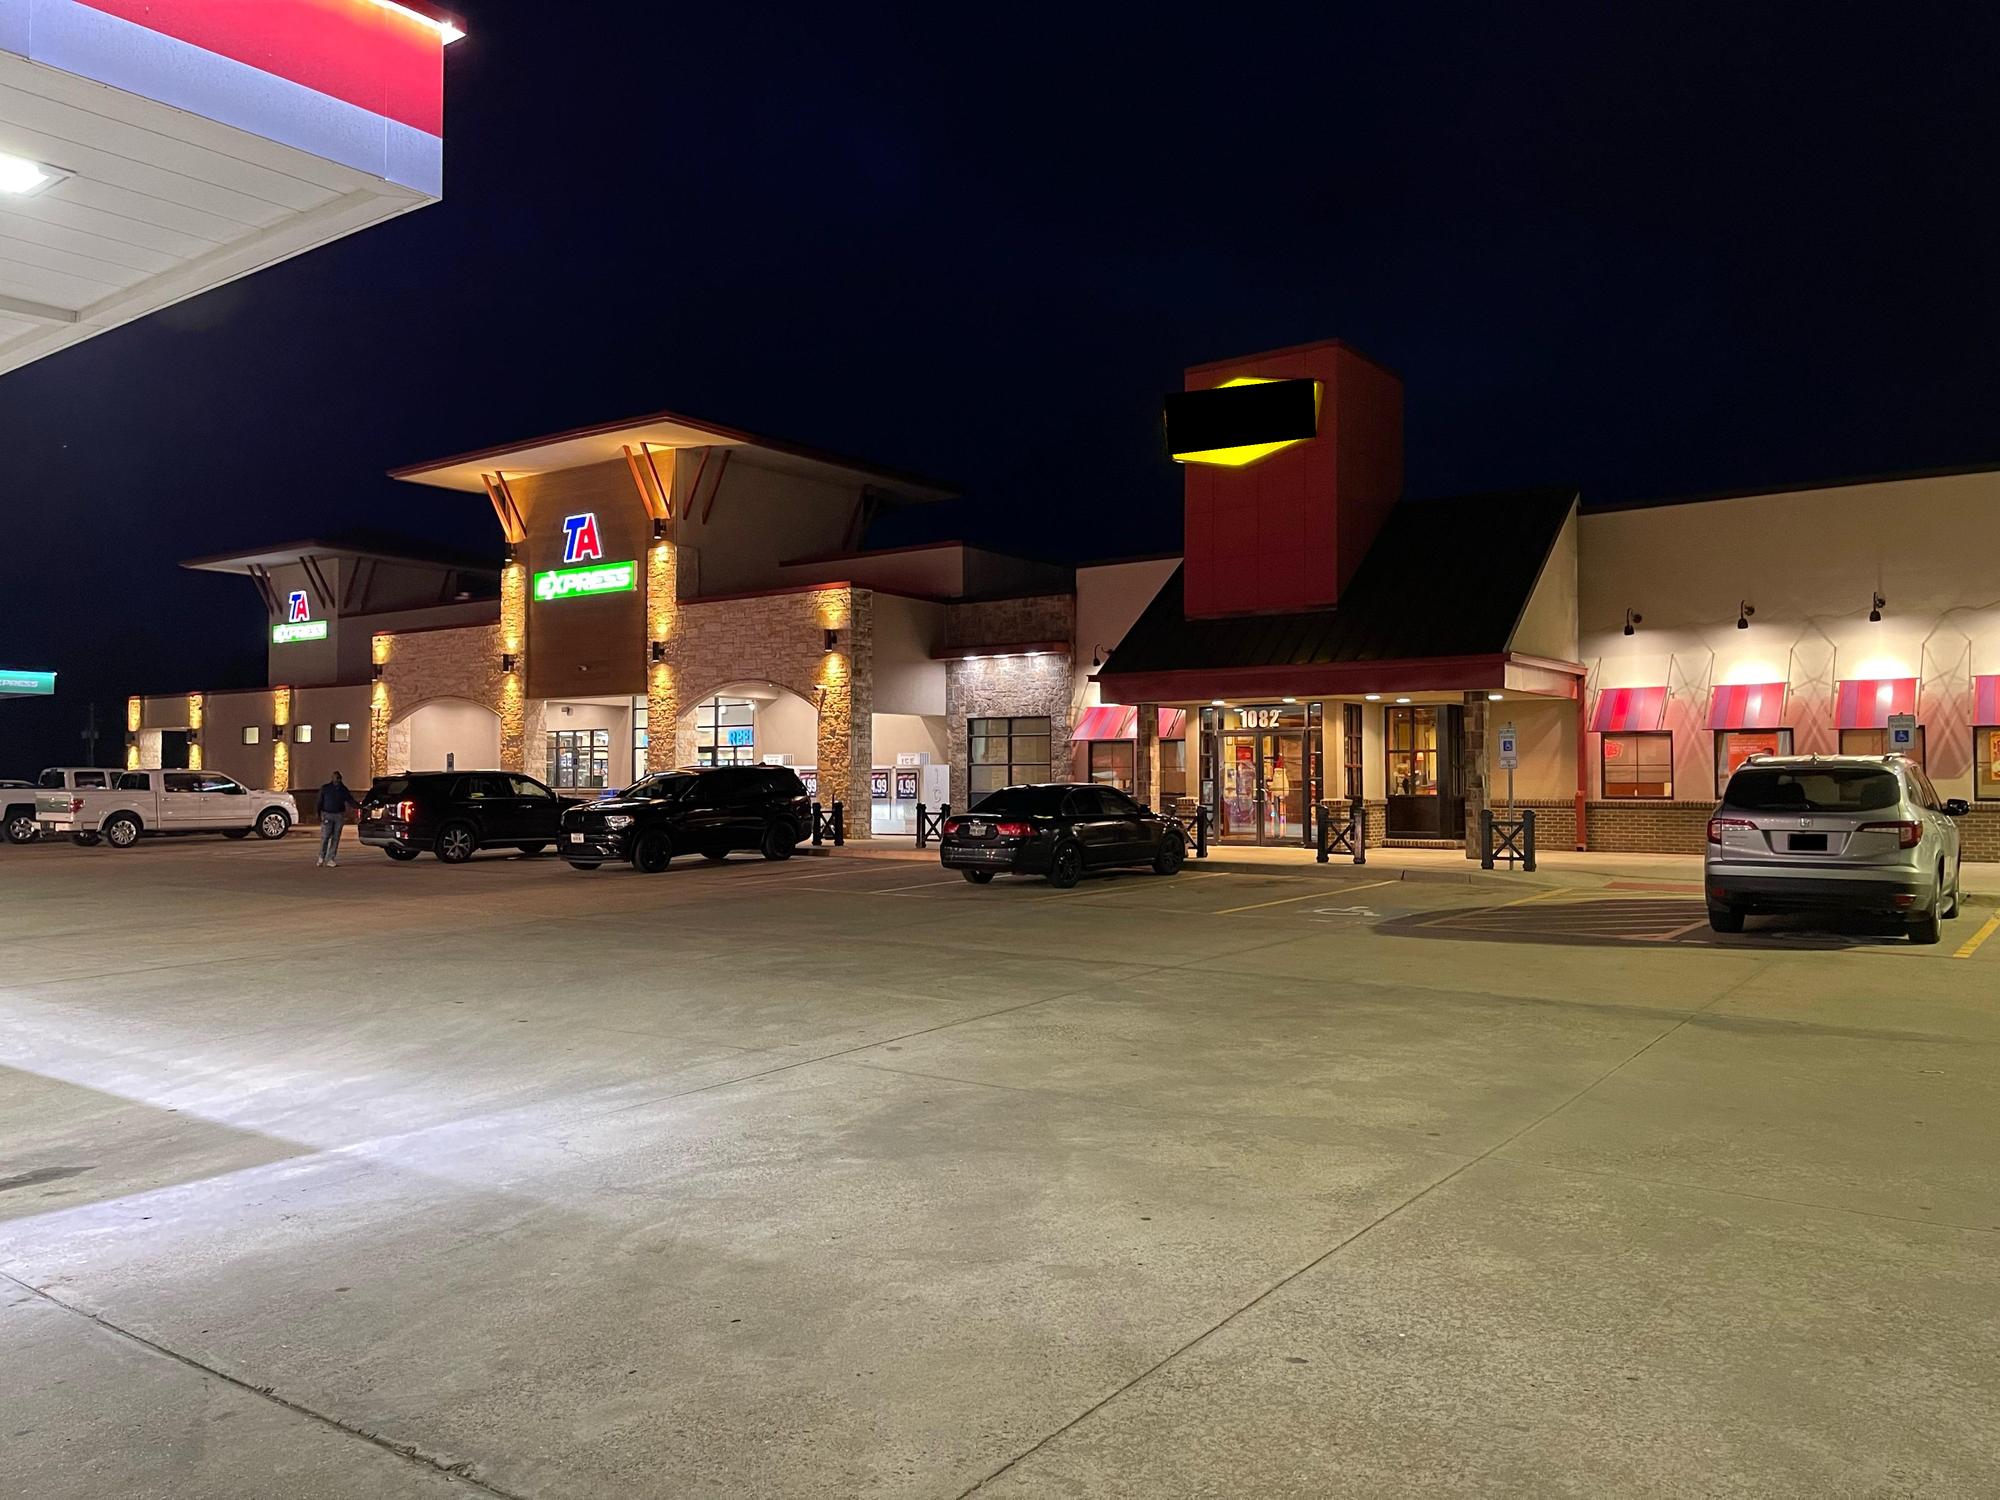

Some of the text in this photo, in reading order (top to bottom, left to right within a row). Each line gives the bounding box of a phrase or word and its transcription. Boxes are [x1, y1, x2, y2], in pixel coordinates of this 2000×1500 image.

[563, 512, 602, 563] TA
[537, 566, 632, 600] EXPRESS
[289, 590, 310, 623] TA
[1240, 709, 1280, 728] 1082
[901, 757, 915, 765] ICE
[898, 779, 916, 794] 4.99
